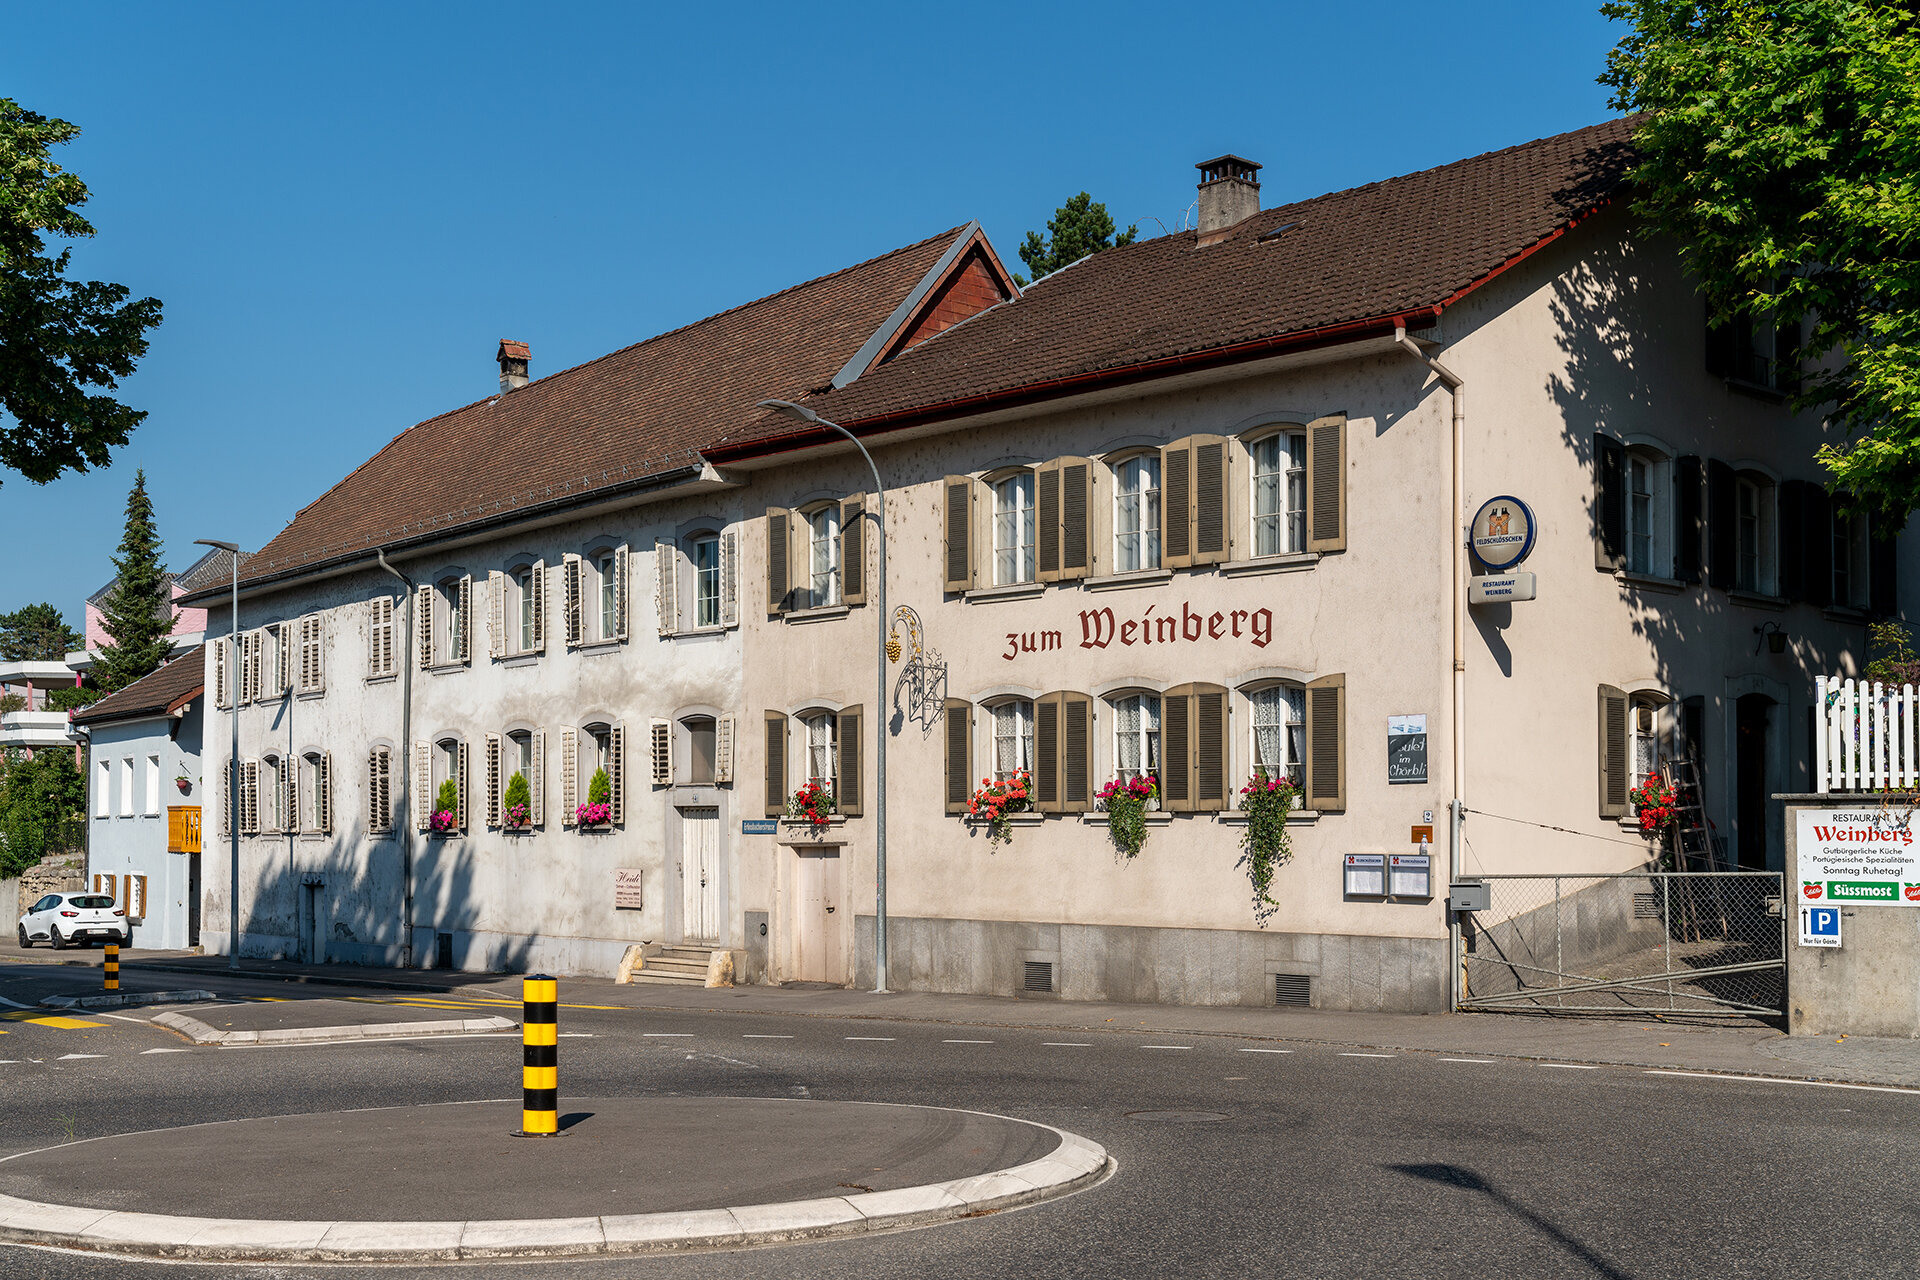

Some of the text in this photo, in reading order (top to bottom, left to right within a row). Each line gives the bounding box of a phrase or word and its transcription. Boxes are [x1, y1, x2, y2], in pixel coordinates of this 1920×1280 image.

[1476, 535, 1522, 545] FELDSCHLÖSSCHEN
[1482, 580, 1515, 588] RESTAURANT
[1002, 600, 1273, 661] zum Weinberg
[1399, 754, 1411, 764] im
[1812, 825, 1914, 847] Weinberg
[1822, 847, 1903, 856] Gutbürgerliche Küche
[1865, 855, 1915, 864] Spezialitäten
[1823, 866, 1904, 877] Sonntag Ruhetag!
[1833, 884, 1893, 897] Süssmost
[1818, 912, 1831, 931] P
